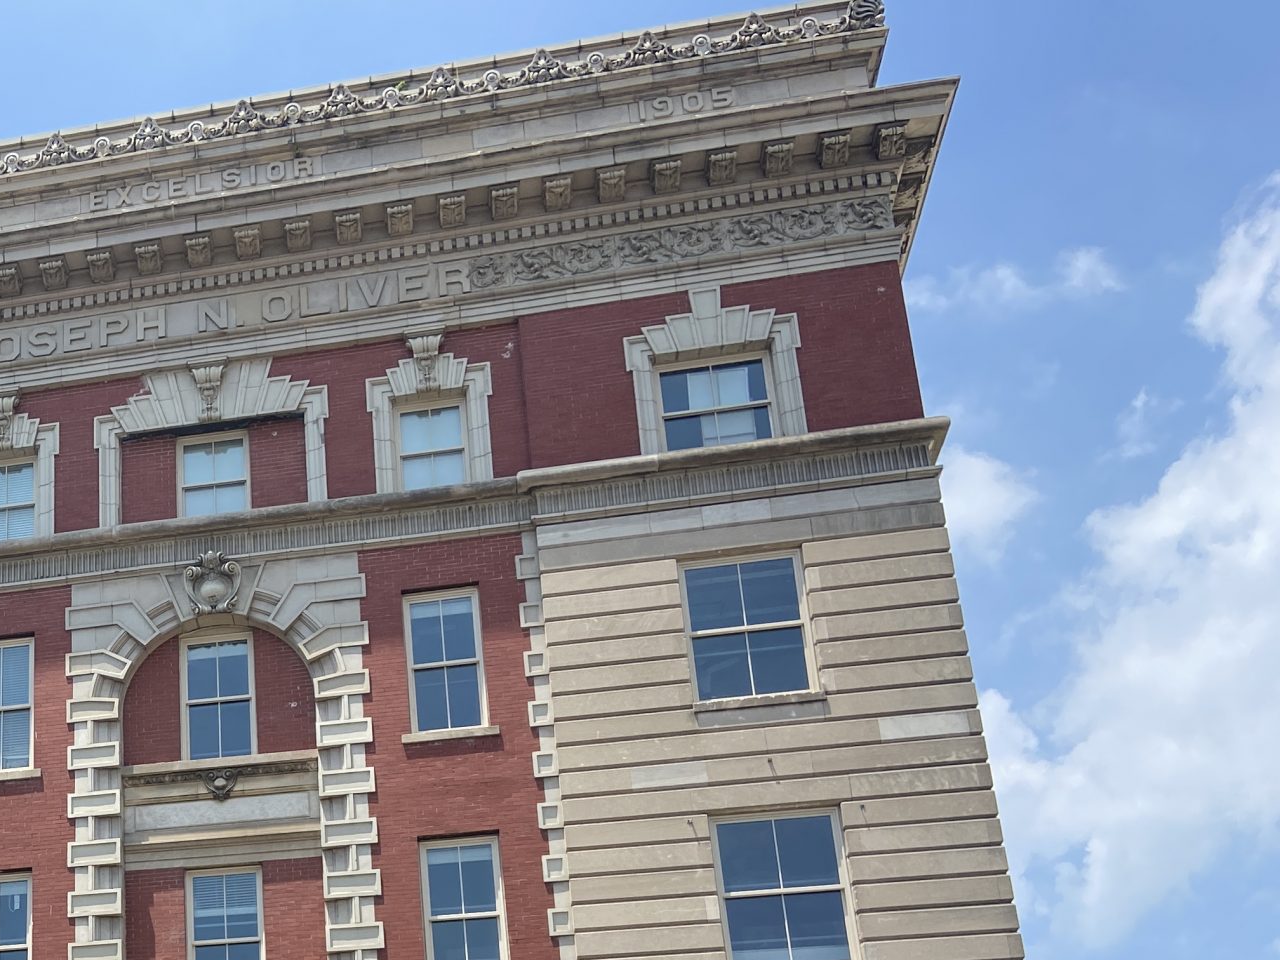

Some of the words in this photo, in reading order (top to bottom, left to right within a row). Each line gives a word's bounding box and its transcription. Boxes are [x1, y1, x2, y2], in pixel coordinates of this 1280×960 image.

[637, 86, 734, 122] 1905
[89, 157, 315, 213] EXCELSIOR
[198, 302, 245, 332] N.
[261, 261, 472, 323] OLIVER
